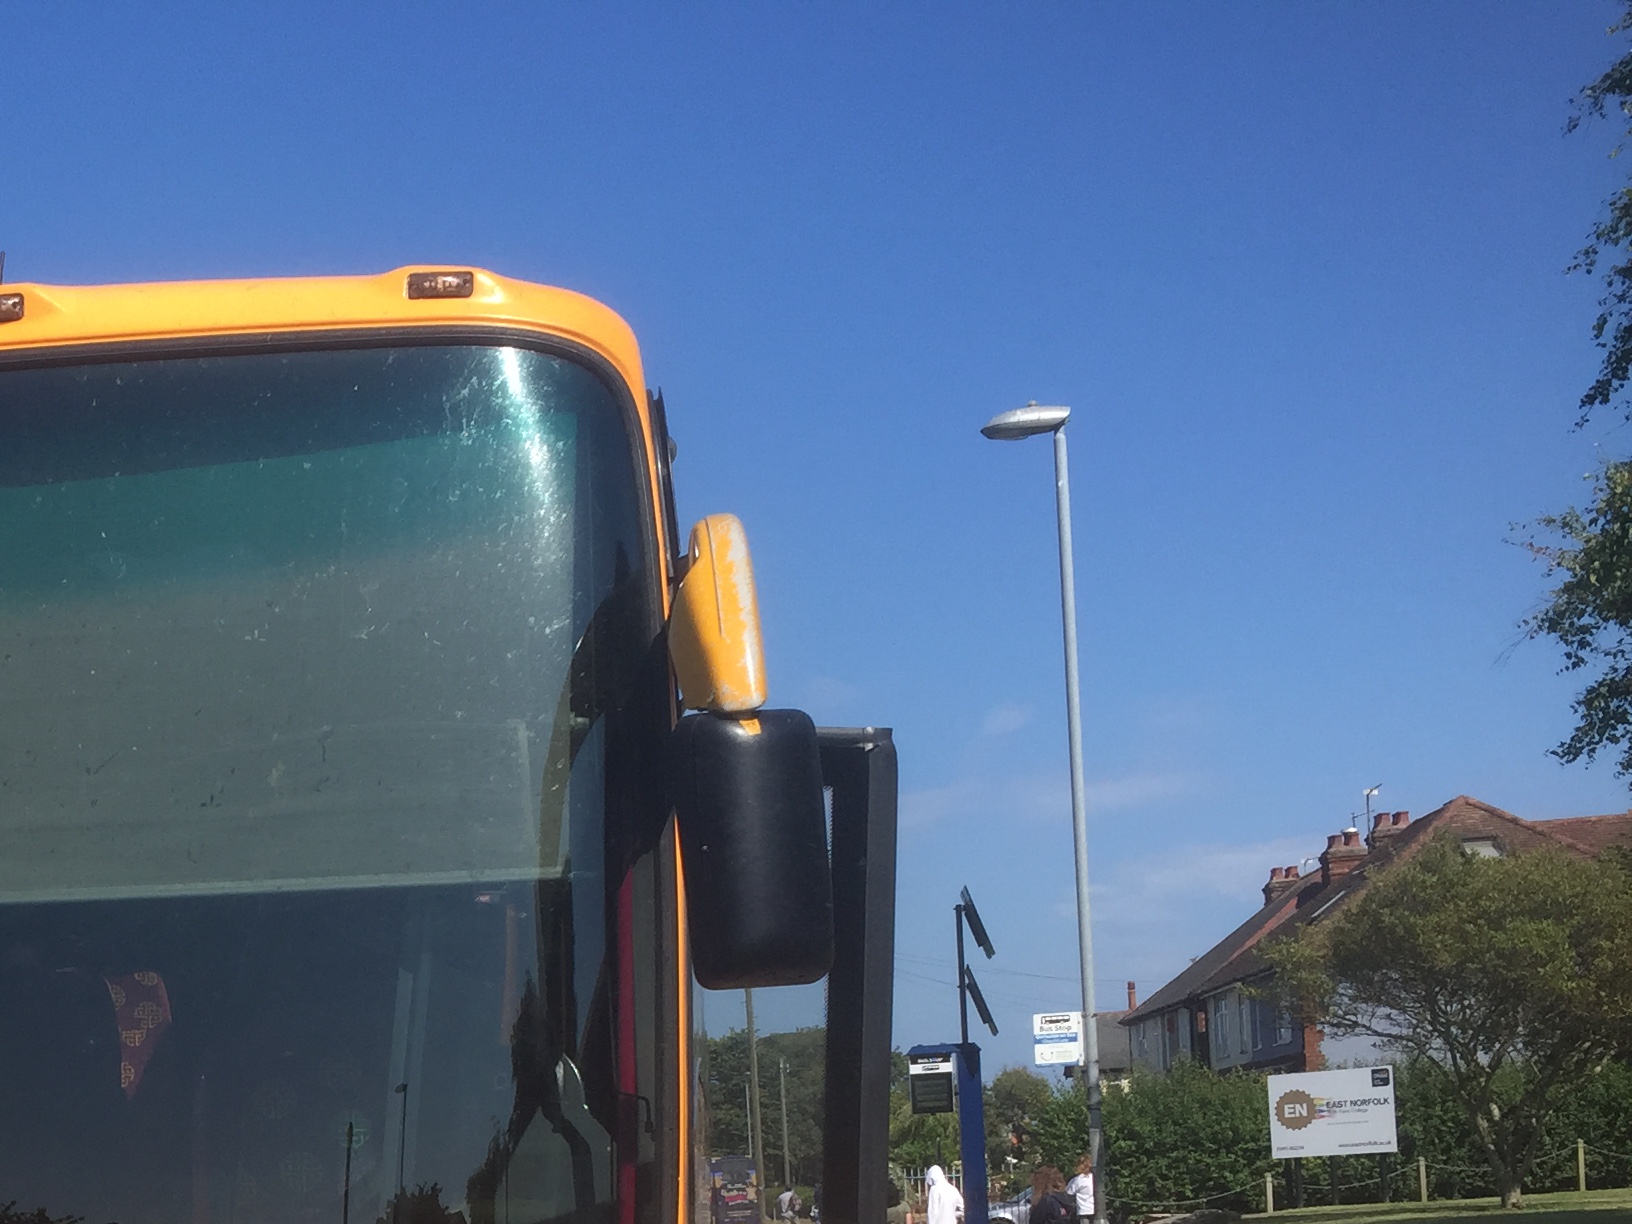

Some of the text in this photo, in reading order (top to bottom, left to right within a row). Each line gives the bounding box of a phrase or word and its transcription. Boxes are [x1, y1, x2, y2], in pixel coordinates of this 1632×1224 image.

[1039, 1024, 1072, 1033] Bus Stop
[1325, 1097, 1390, 1108] EAST NORFOLK
[1283, 1102, 1308, 1119] EN
